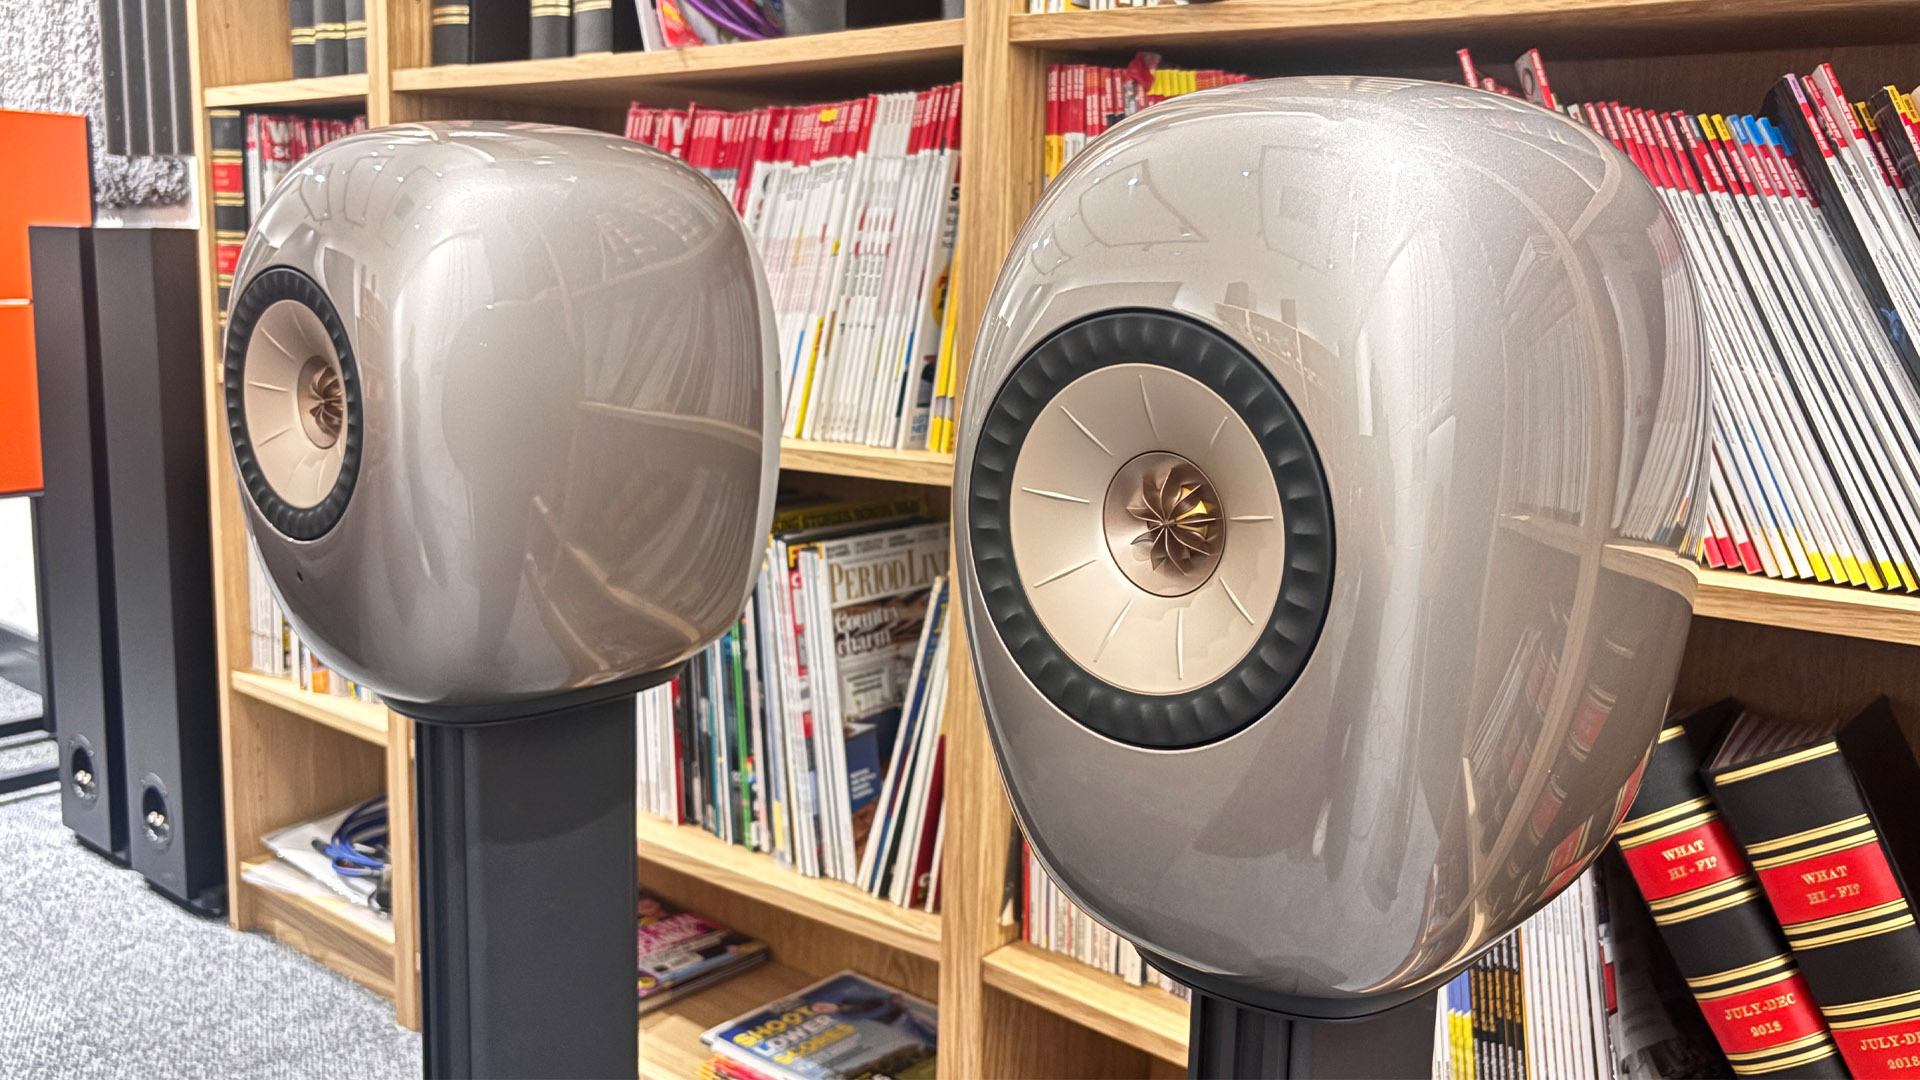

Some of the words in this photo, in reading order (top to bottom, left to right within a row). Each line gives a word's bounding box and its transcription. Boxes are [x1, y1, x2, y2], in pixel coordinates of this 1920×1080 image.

[1661, 839, 1705, 861] WHAT
[1800, 865, 1848, 885] WHAT
[1724, 992, 1797, 1021] JULY-DEC
[1750, 1020, 1783, 1037] 2018
[1887, 1055, 1920, 1070] 2018
